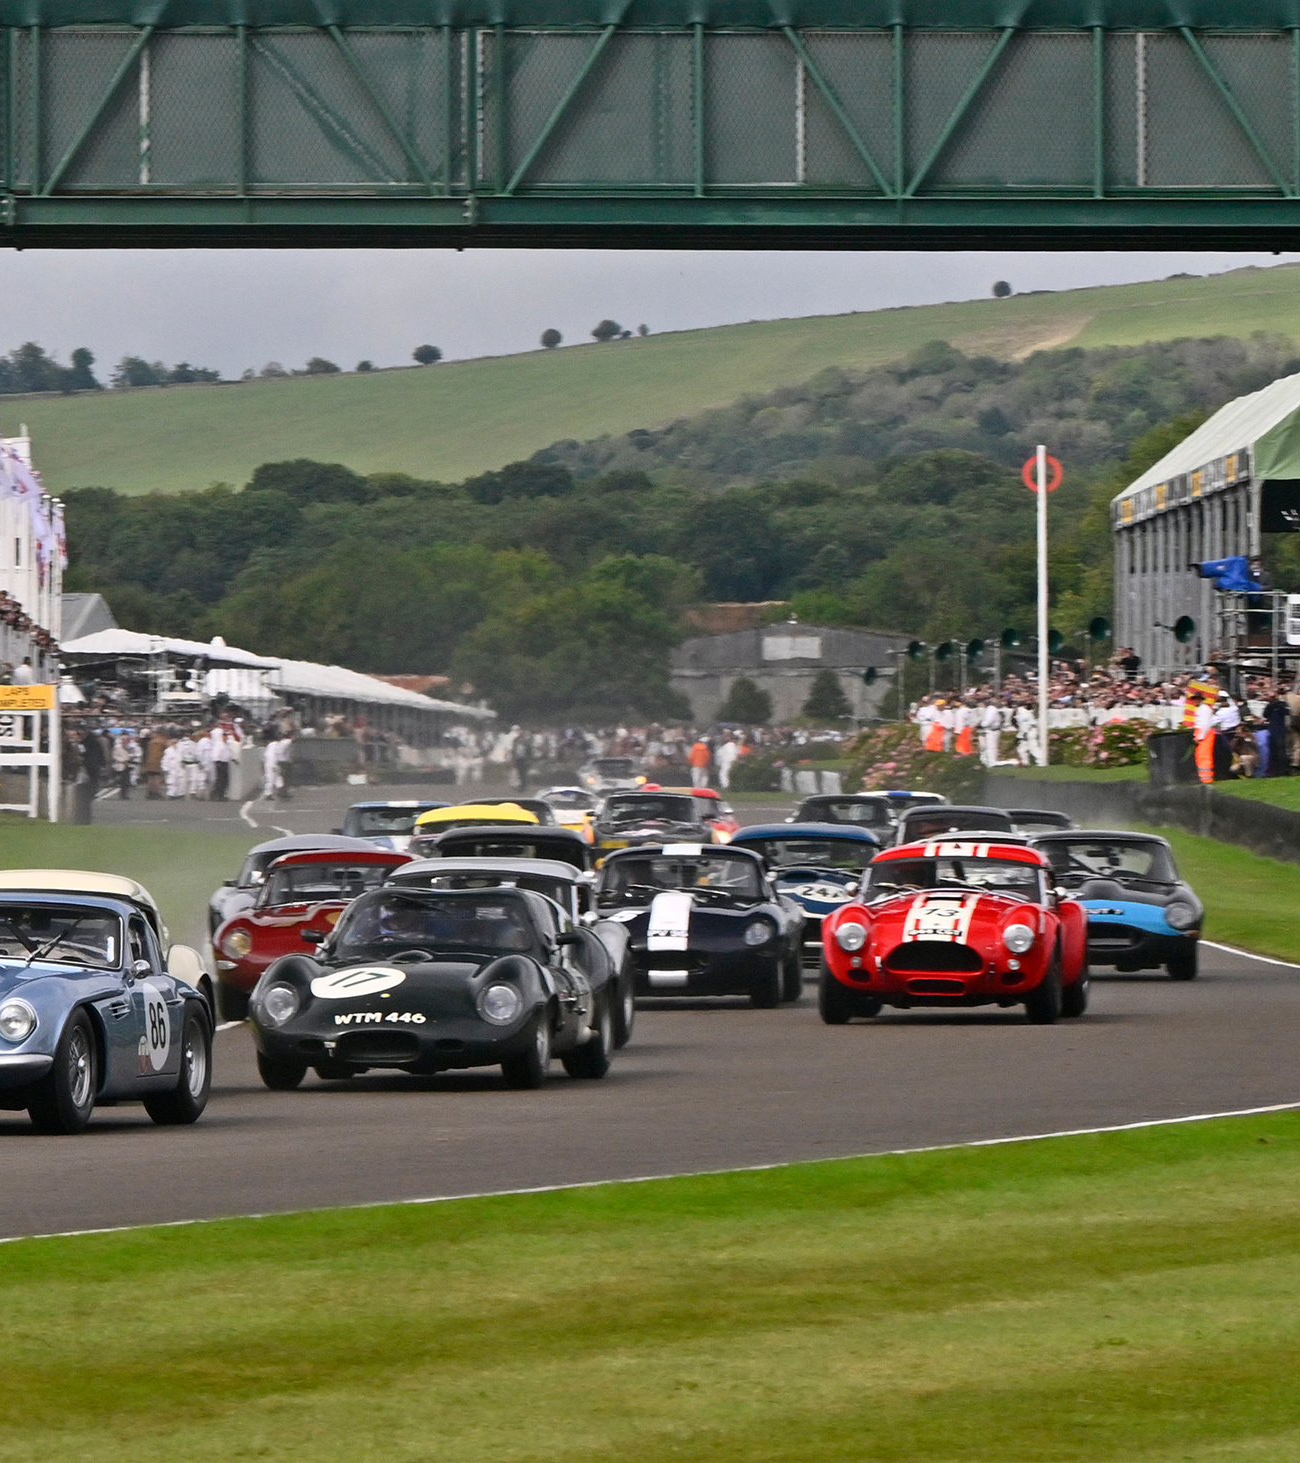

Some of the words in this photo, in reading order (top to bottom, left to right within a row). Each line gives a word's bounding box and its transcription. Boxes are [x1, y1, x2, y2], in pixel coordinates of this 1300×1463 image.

[3, 687, 30, 697] LAPS
[925, 907, 960, 918] 13
[328, 971, 390, 989] 17
[334, 1012, 383, 1025] WTM
[384, 1012, 427, 1024] 446
[148, 1001, 167, 1050] 86
